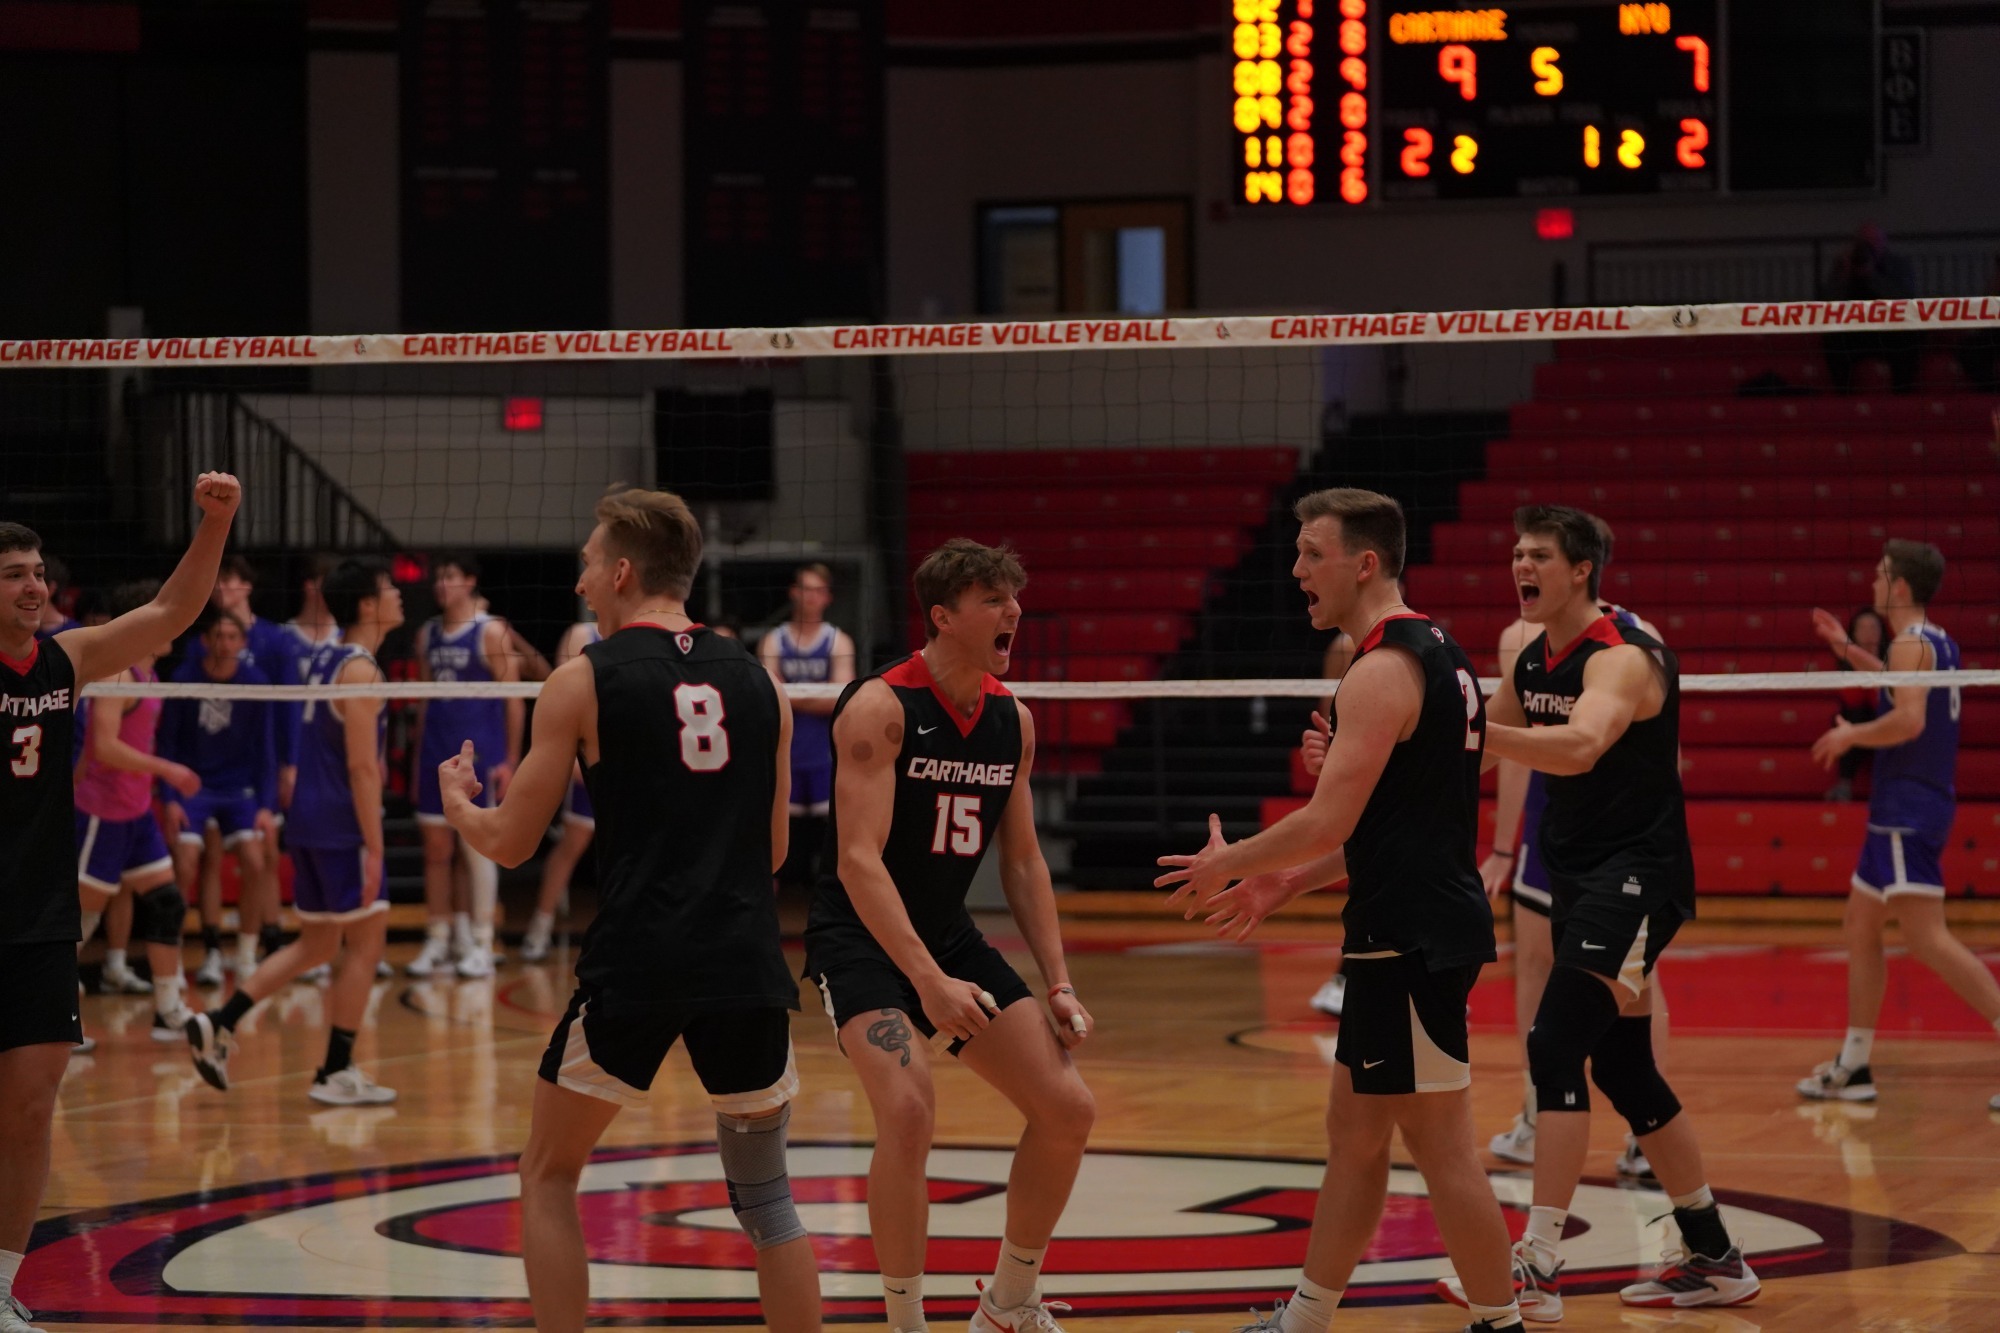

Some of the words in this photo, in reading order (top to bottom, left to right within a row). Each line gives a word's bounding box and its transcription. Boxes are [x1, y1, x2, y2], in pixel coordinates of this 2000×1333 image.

[1439, 44, 1477, 101] 9
[1530, 46, 1564, 96] 5
[1675, 35, 1710, 92] 7
[1245, 136, 1282, 168] 11
[1400, 127, 1433, 178] 2
[1450, 134, 1478, 175] 2
[1583, 125, 1600, 169] 1
[1617, 129, 1645, 169] 2
[1676, 118, 1709, 169] 2
[833, 325, 983, 349] CARTHAGE
[992, 320, 1177, 345] VOLLEYBALL
[1270, 313, 1428, 339] CARTHAGE
[1436, 309, 1631, 334] VOLLEYBALL
[1740, 300, 1909, 327] CARTHAGE
[1916, 297, 2000, 321] VOLL
[1, 339, 140, 361] CARTHAGE
[147, 337, 318, 359] VOLLEYBALL
[403, 334, 547, 356] CARTHAGE
[556, 331, 733, 354] VOLLEYBALL
[672, 681, 732, 773] 8
[1455, 667, 1480, 752] 2
[9, 722, 44, 778] 3
[907, 756, 1015, 786] CARTHAGE
[930, 792, 984, 857] 15
[1628, 875, 1640, 884] XL
